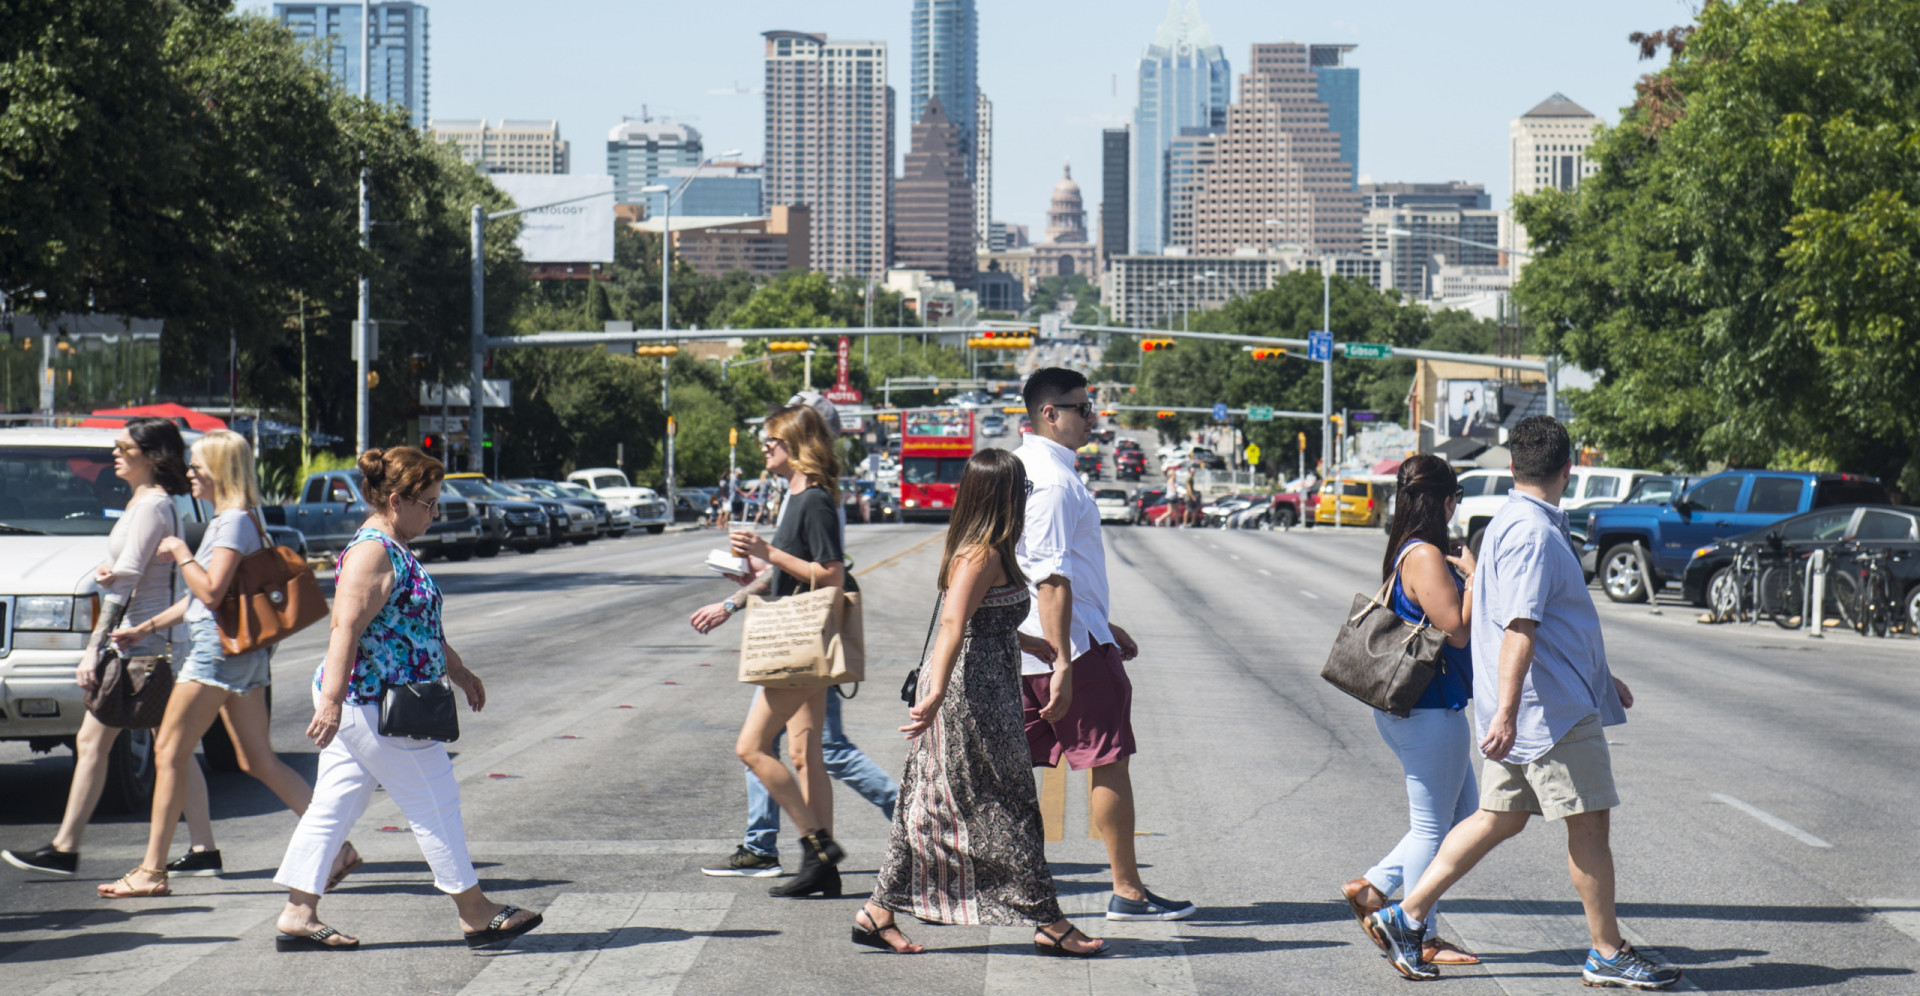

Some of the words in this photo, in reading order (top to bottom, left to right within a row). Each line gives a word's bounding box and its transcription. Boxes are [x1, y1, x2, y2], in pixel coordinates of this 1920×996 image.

[1350, 345, 1379, 356] Gibson
[838, 341, 849, 391] AUSTIN
[826, 391, 858, 402] MOTEL
[761, 649, 791, 659] Angeles
